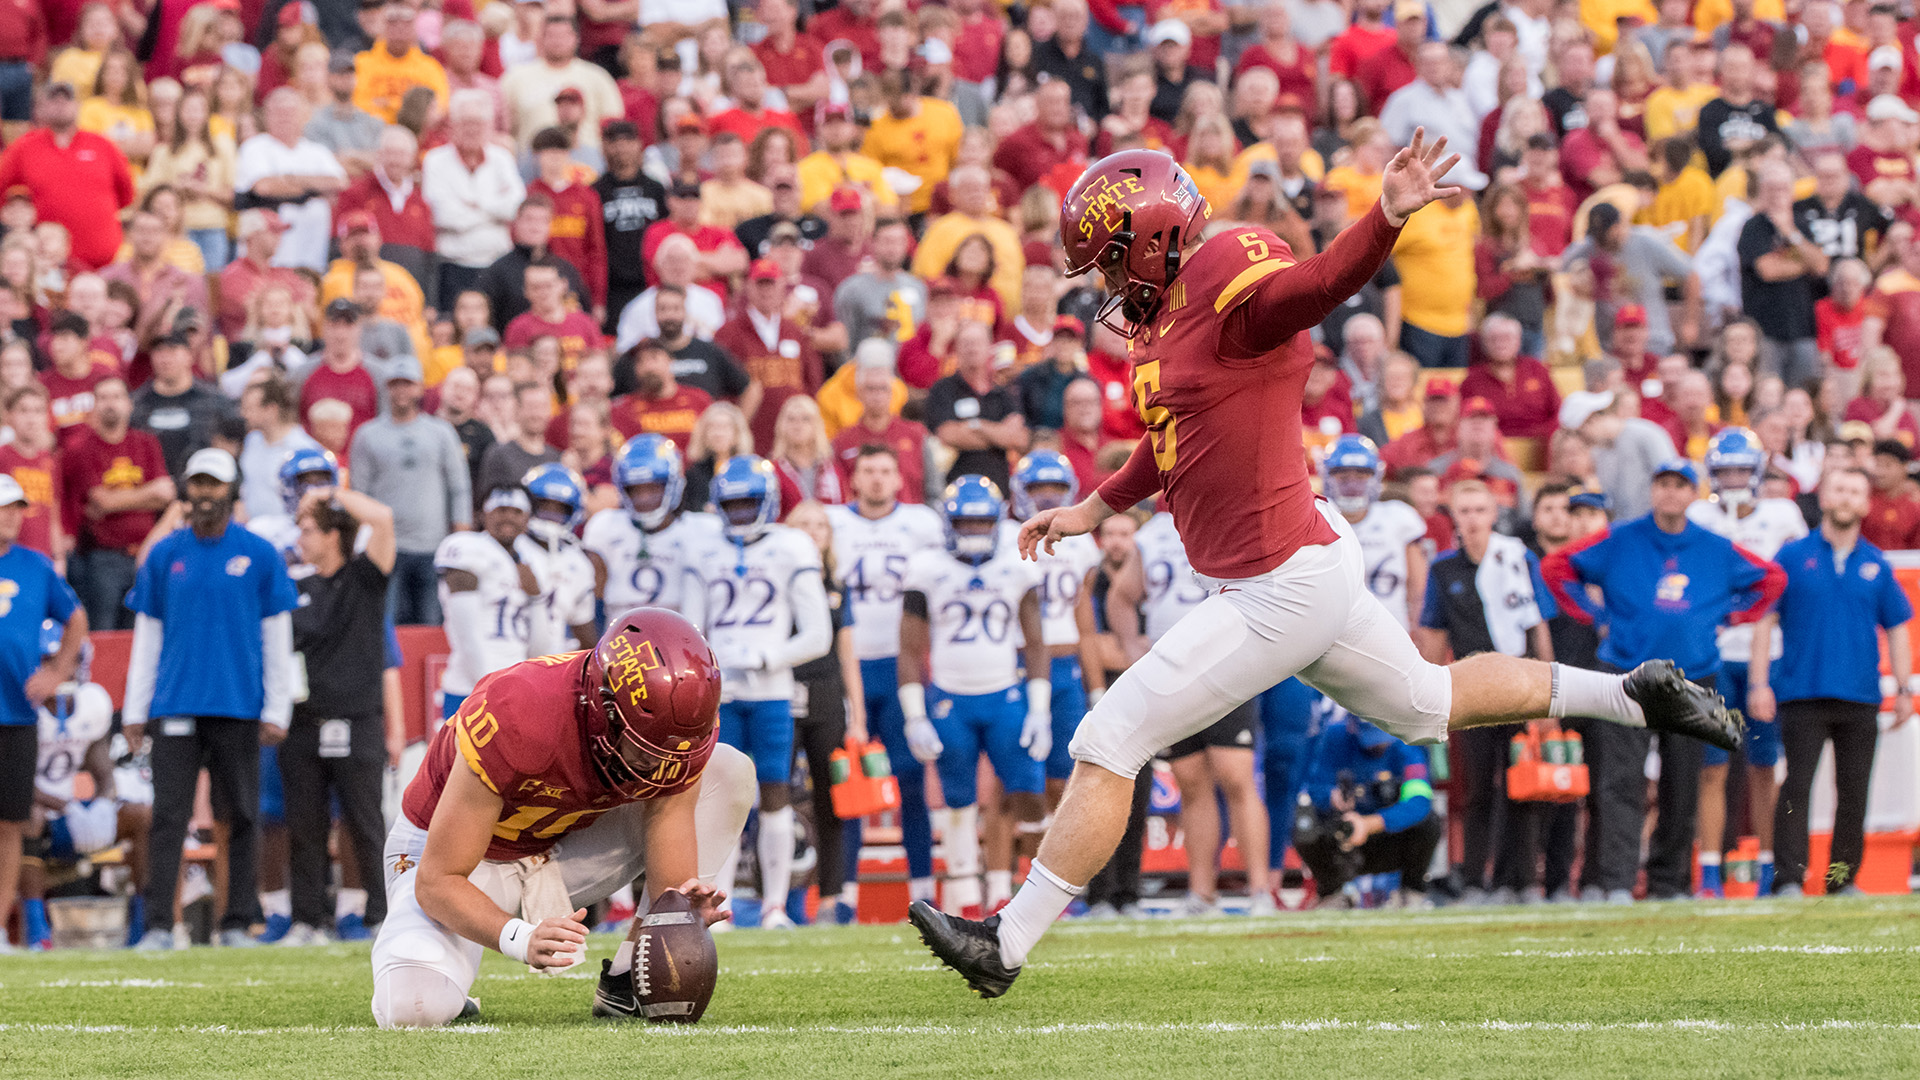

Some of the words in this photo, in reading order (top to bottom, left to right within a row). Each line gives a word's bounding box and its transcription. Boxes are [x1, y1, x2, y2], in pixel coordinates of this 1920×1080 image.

[1079, 177, 1145, 239] STATE
[1237, 232, 1269, 262] 5
[1134, 359, 1177, 471] 5
[631, 566, 664, 604] 9
[707, 578, 777, 627] 22
[846, 555, 908, 602] 45
[941, 600, 1011, 643] 20
[609, 634, 648, 706] STATE
[465, 699, 499, 748] 10
